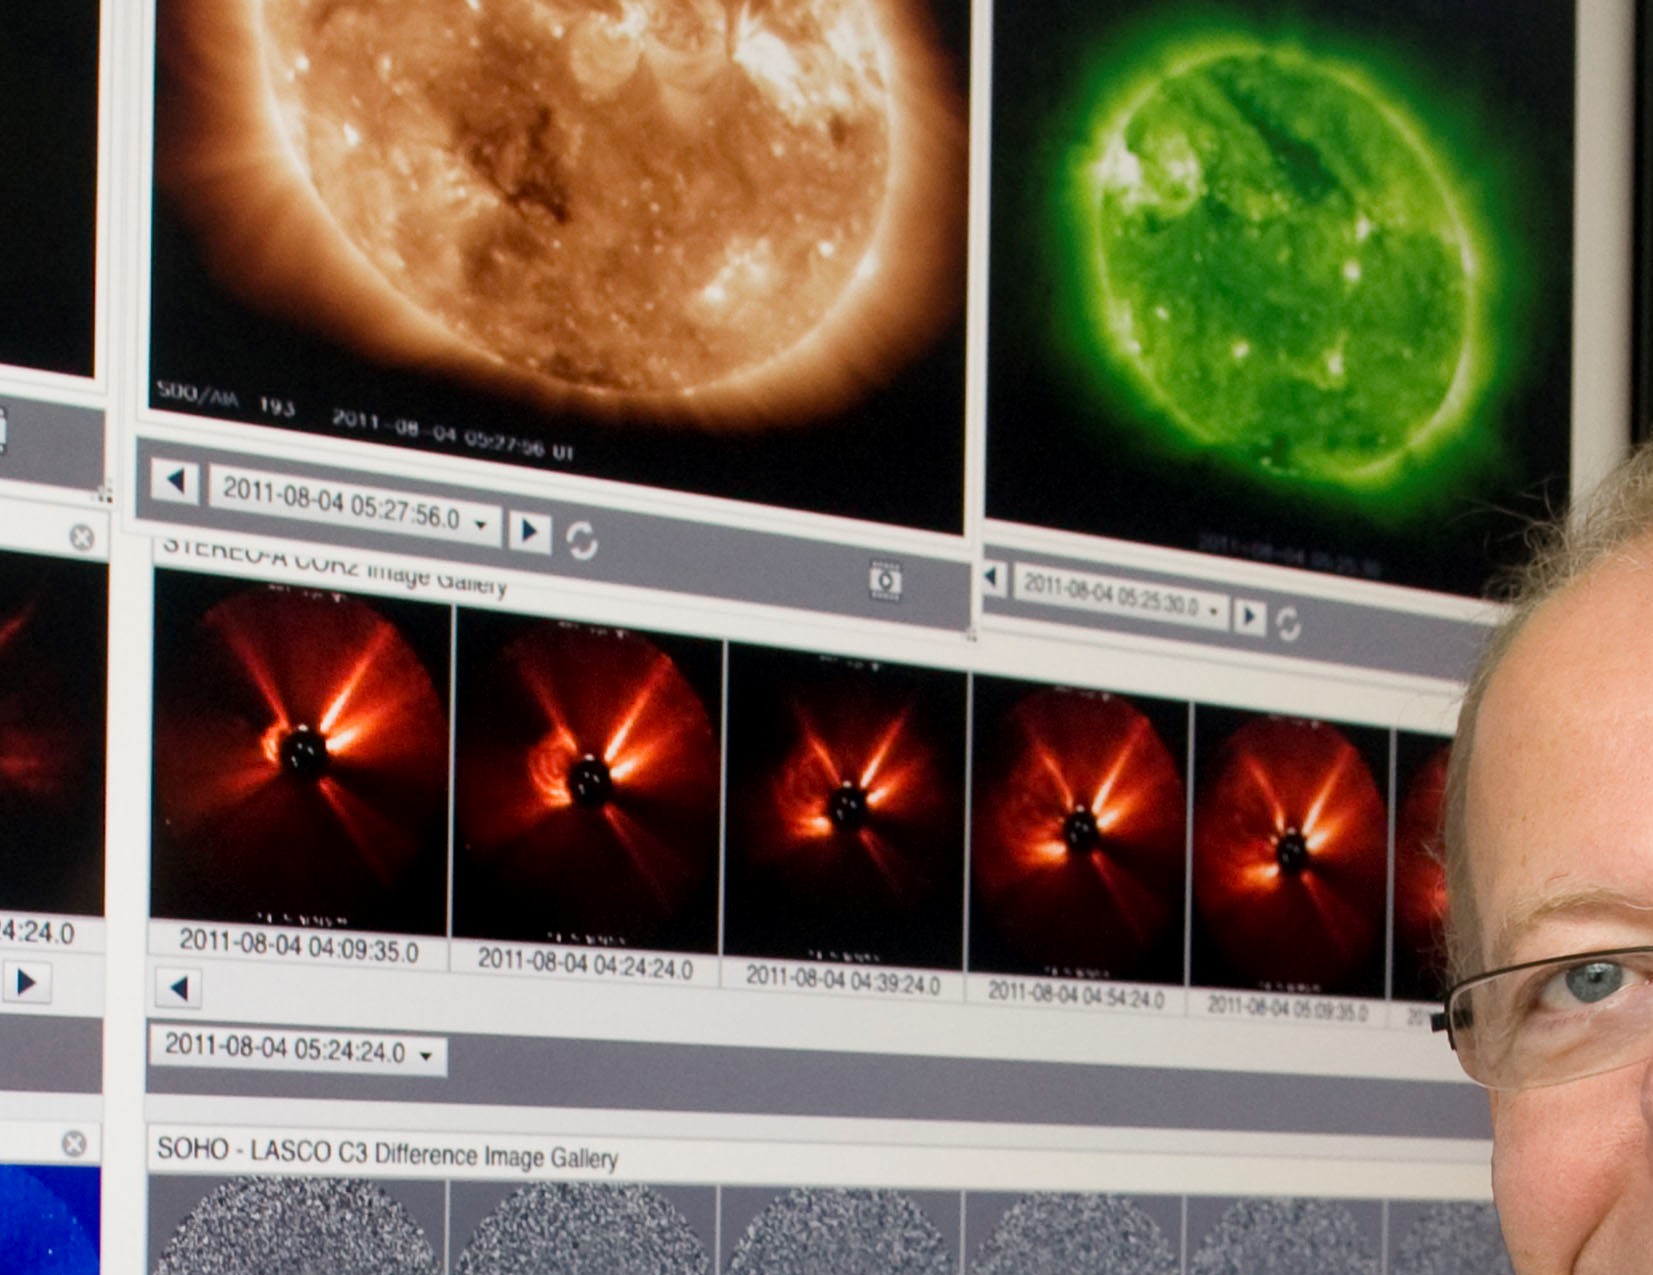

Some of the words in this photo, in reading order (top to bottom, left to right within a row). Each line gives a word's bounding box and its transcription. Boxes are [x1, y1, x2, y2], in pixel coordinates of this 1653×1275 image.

[260, 396, 296, 417] 193
[223, 475, 344, 513] 2011-08-04
[351, 494, 460, 530] 05:27:56.0
[1023, 571, 1113, 602] 2011-08-04
[1117, 586, 1199, 617] 05:25:30.0
[0, 919, 75, 945] 4:24.0
[180, 927, 303, 956] 2011-08-04
[308, 934, 419, 964] 04:09:35.0
[478, 947, 588, 974] 2011-08-04
[594, 953, 694, 981] 04:24:24.0
[746, 964, 846, 989] 2011-08-04
[850, 970, 941, 996] 04:39:24.0
[988, 980, 1079, 1005] 2011-08-04
[1082, 984, 1165, 1009] 04:54:24.0
[1207, 994, 1290, 1017] 2011-08-04
[165, 1031, 288, 1058] 2011-08-04
[294, 1035, 406, 1064] 05:24:24.0
[157, 1135, 229, 1161] SOHO
[251, 1138, 333, 1164] LASCO
[338, 1141, 369, 1165] C3
[375, 1141, 479, 1168] Difference
[485, 1144, 546, 1173] Image
[551, 1146, 619, 1174] Gallery
